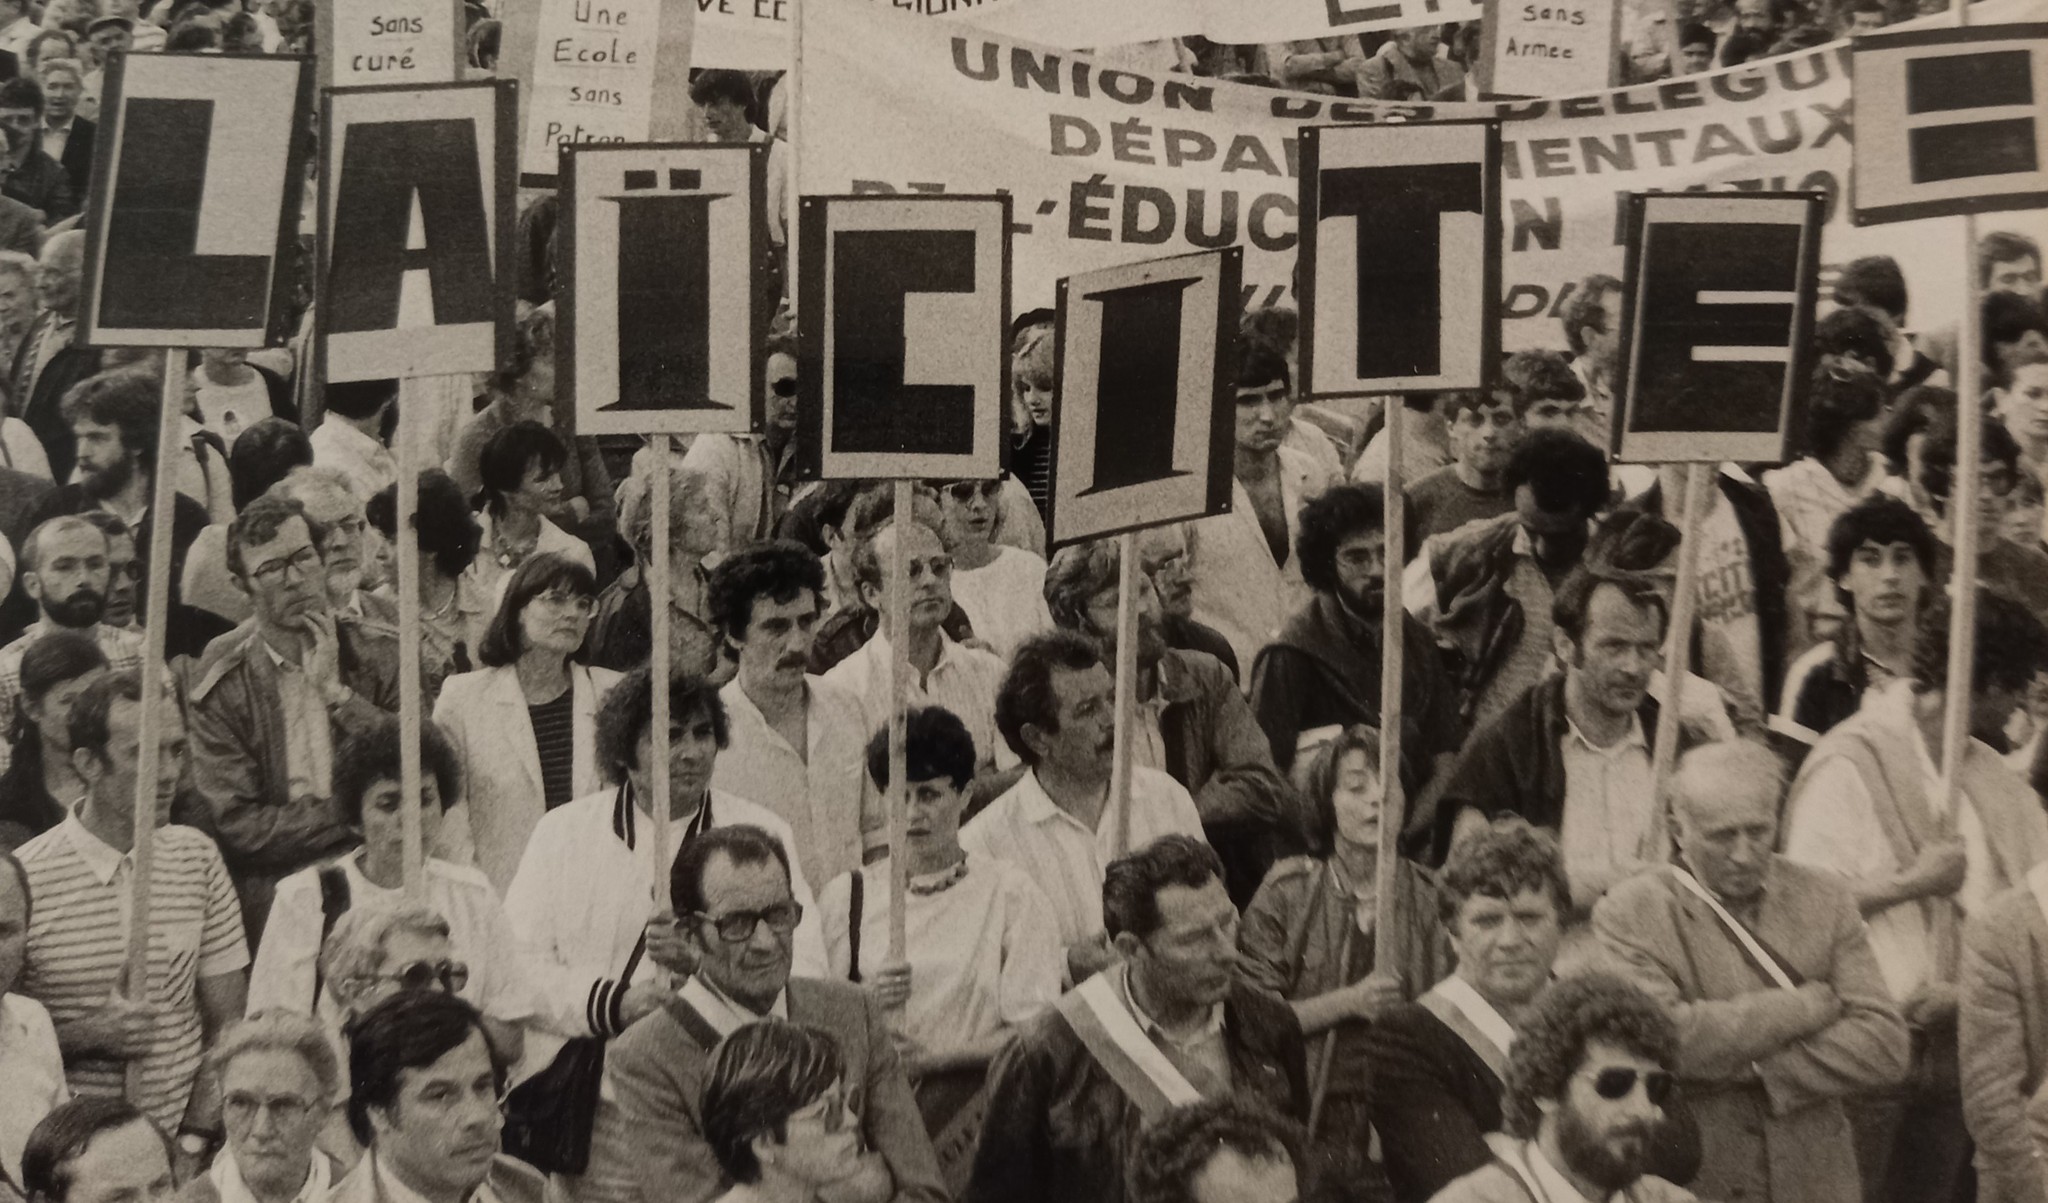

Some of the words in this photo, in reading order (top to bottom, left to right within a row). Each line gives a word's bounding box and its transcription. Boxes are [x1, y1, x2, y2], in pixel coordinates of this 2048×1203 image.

[575, 0, 628, 26] Une
[351, 47, 416, 71] curé
[553, 38, 638, 64] Ecole
[951, 36, 1216, 114] UNION
